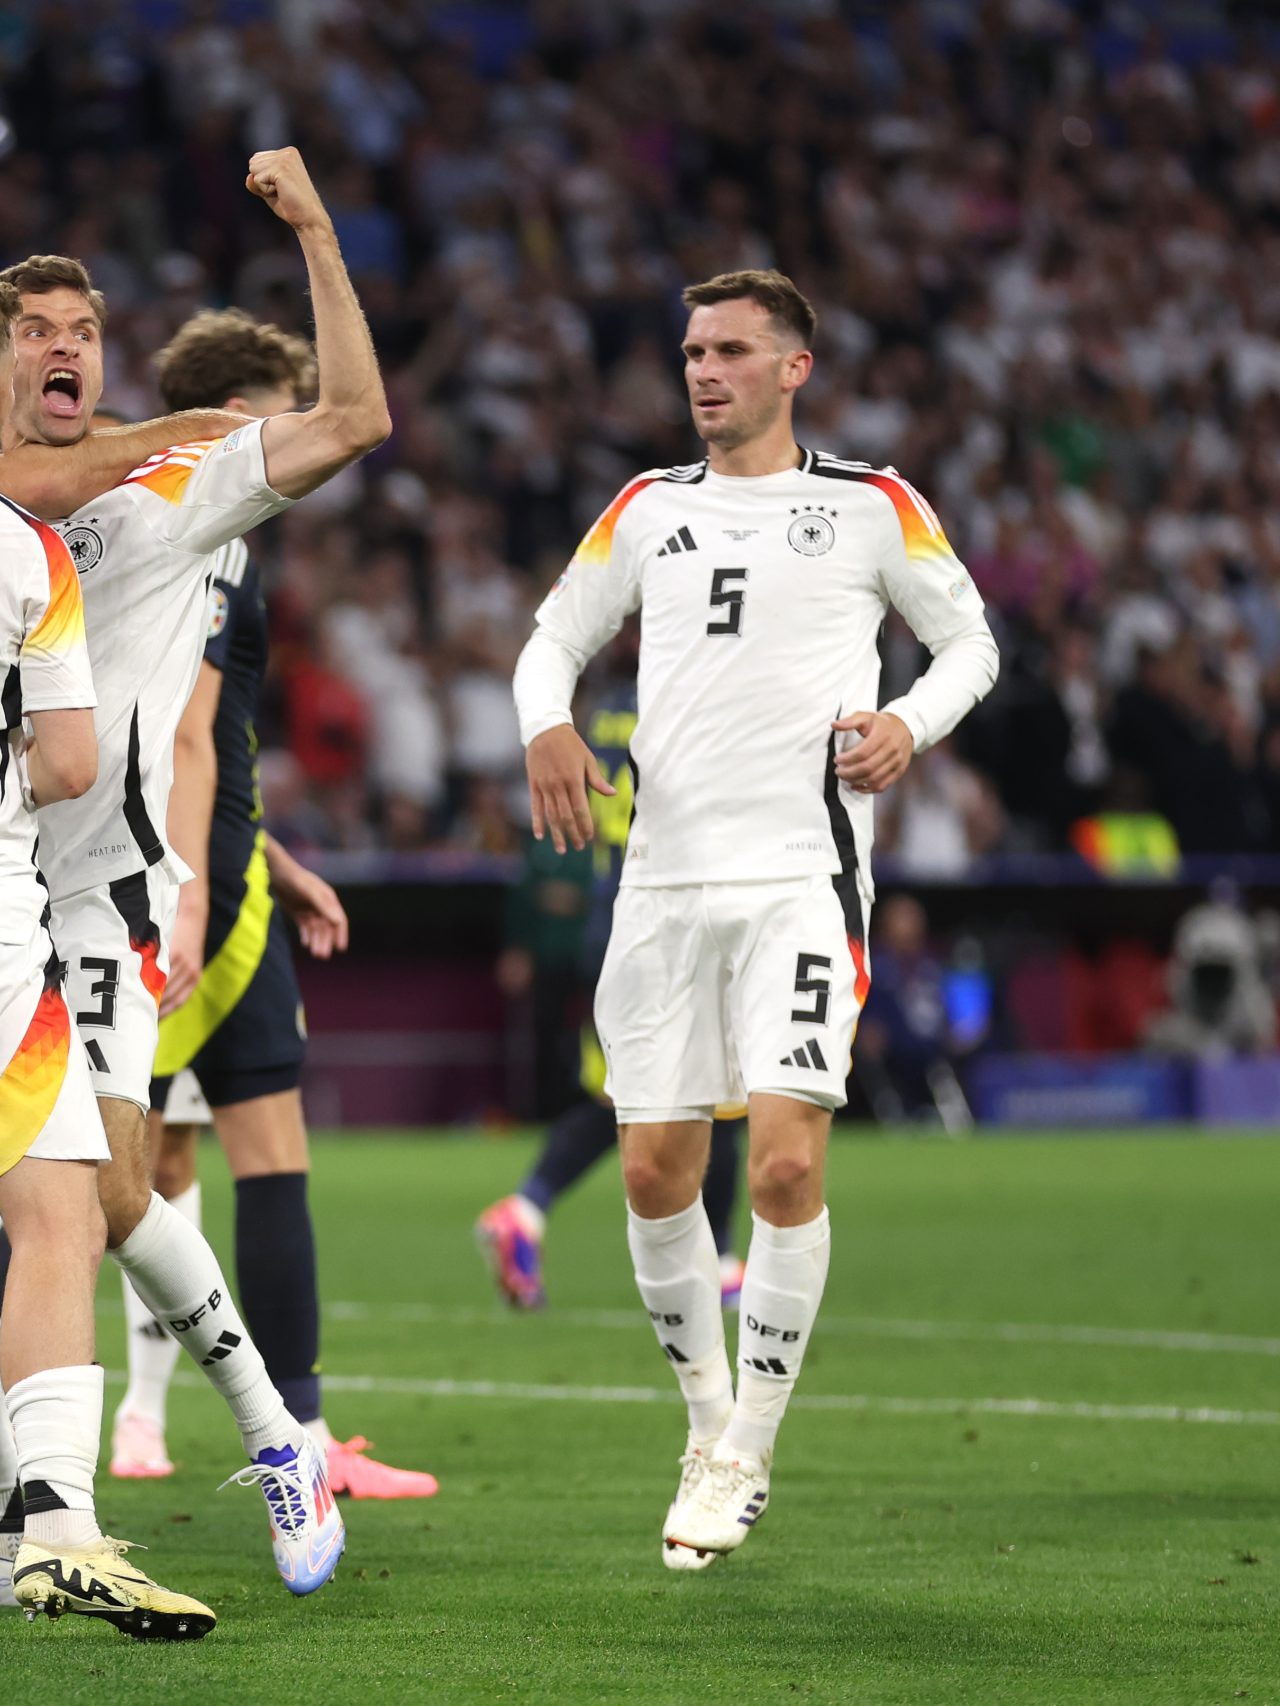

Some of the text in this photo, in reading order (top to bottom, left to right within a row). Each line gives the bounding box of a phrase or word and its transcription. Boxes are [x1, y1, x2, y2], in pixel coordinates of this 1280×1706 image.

[707, 568, 750, 638] 5
[59, 956, 121, 1030] 3
[791, 952, 834, 1028] 5
[168, 1289, 221, 1332] DFB
[649, 1311, 685, 1327] FB
[746, 1314, 800, 1342] DFB
